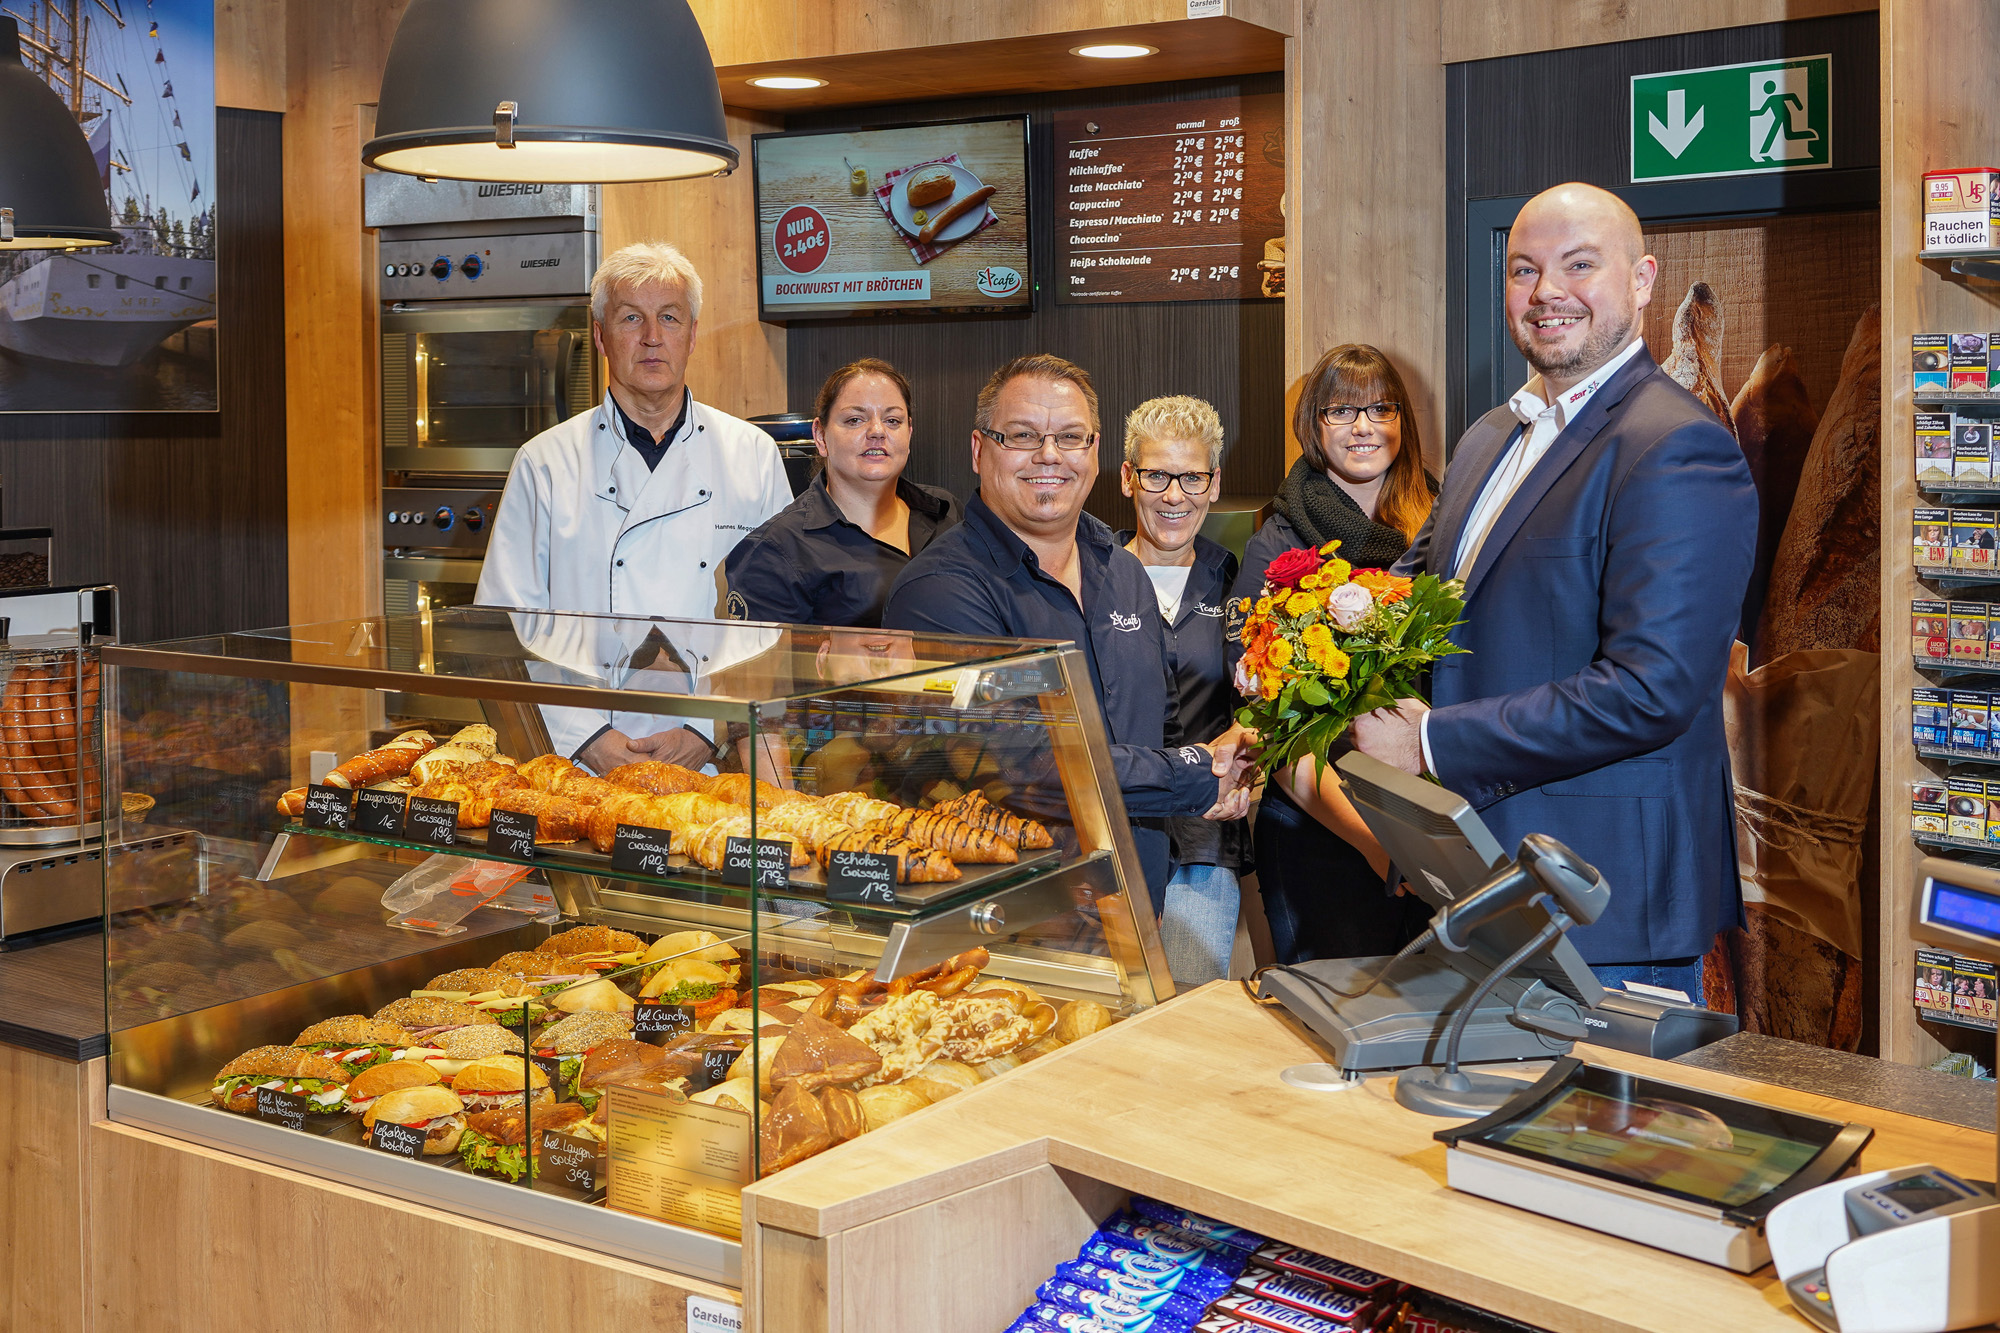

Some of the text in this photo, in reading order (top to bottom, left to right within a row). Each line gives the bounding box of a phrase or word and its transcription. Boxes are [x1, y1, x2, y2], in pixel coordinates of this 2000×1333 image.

[1176, 117, 1240, 129] normal groß
[478, 184, 543, 197] WIESHEU
[1070, 183, 1092, 193] Latte
[786, 216, 814, 238] NUR
[1930, 220, 1982, 231] Rauchen
[783, 230, 825, 257] 2,40€
[1927, 233, 1986, 245] ist tödlich
[520, 258, 560, 268] WIESHEU
[1070, 256, 1152, 268] Heiße Schokolade
[776, 278, 923, 296] BOCKWURST MIT BRÖTCHEN
[994, 272, 1016, 290] café
[1070, 276, 1085, 285] Tee
[1570, 390, 1587, 403] star
[378, 814, 396, 829] 1€
[493, 811, 520, 824] Käse-
[1952, 821, 1980, 829] CAMEL
[834, 852, 886, 866] Schoko-
[635, 1023, 673, 1032] Chicken
[1584, 1018, 1608, 1029] EPSON
[1265, 1275, 1360, 1314] SNICKERS
[693, 1307, 742, 1329] Carstens
[1246, 1301, 1340, 1333] SNICKERS
